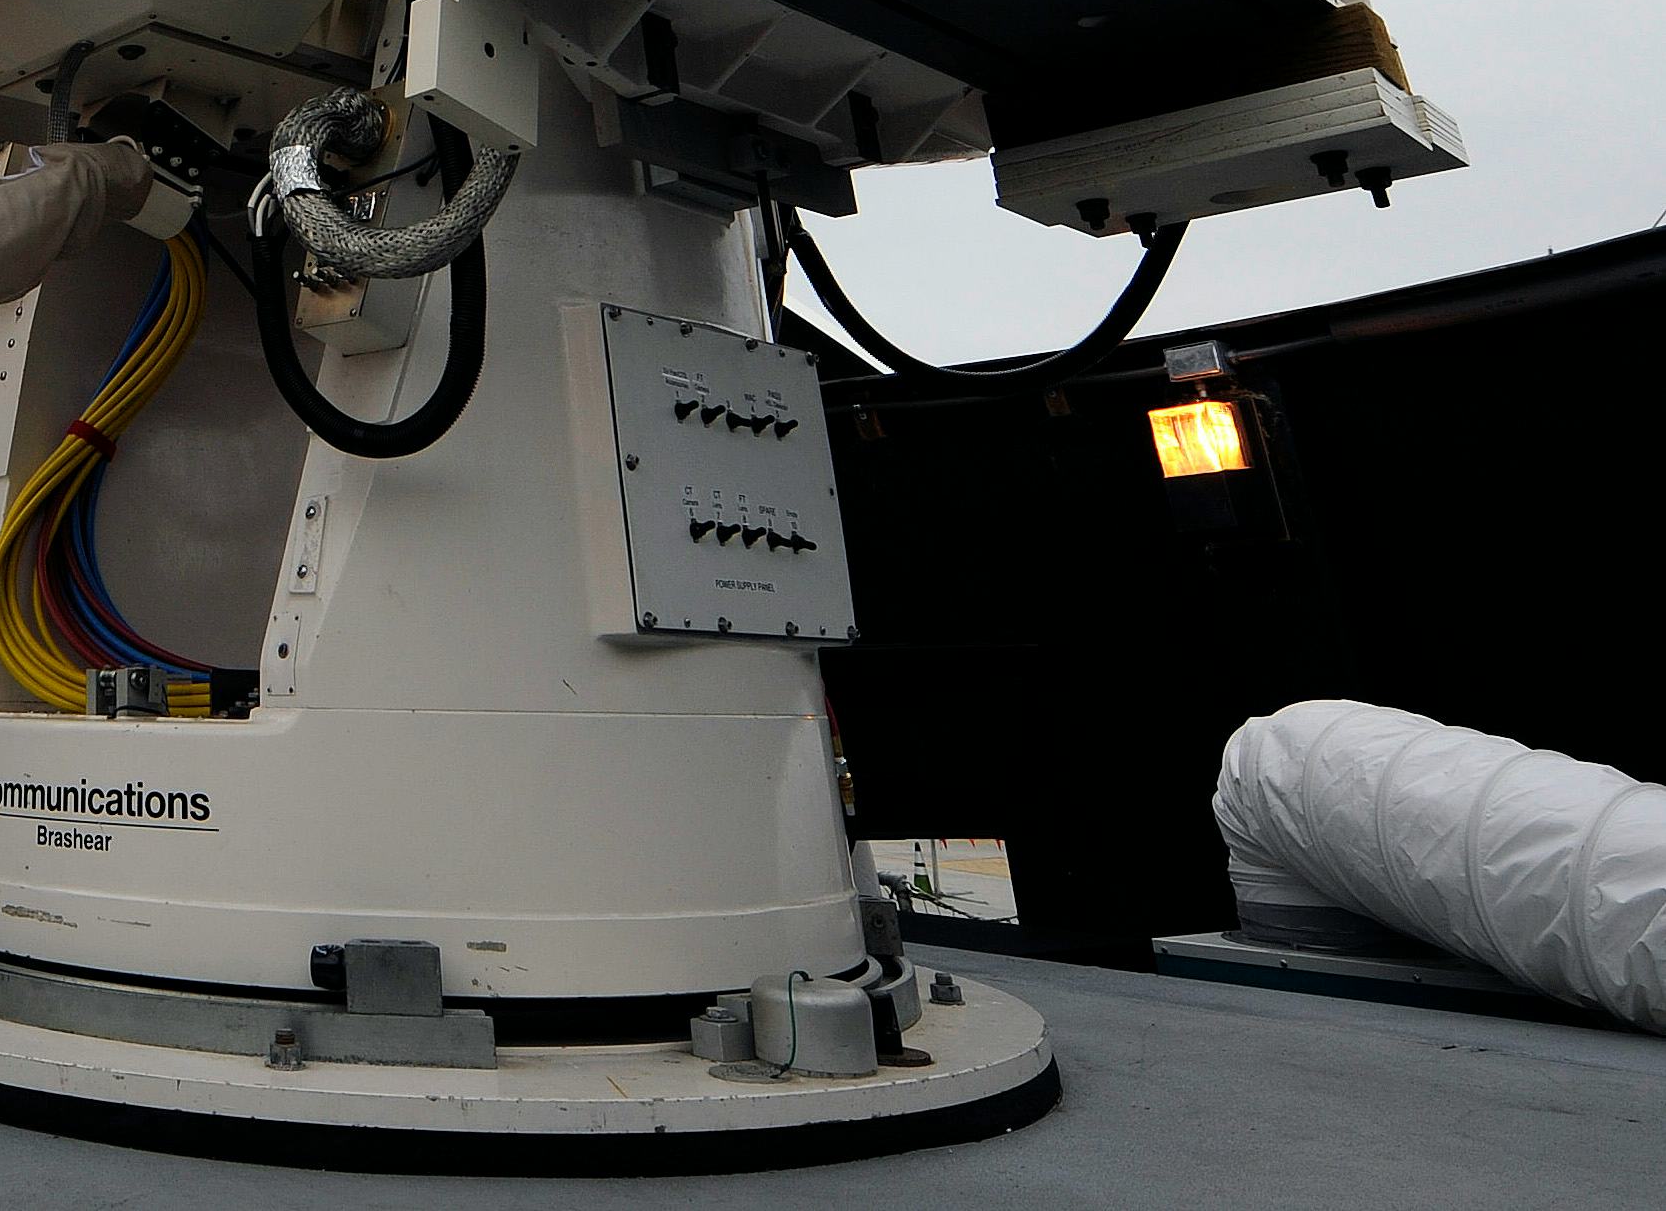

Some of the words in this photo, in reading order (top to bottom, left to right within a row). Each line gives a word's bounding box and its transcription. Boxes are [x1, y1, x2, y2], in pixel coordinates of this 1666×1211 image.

[715, 579, 735, 589] POWER
[736, 580, 757, 591] SUPPLY
[758, 582, 775, 593] PANEL
[36, 824, 113, 852] Brashear
